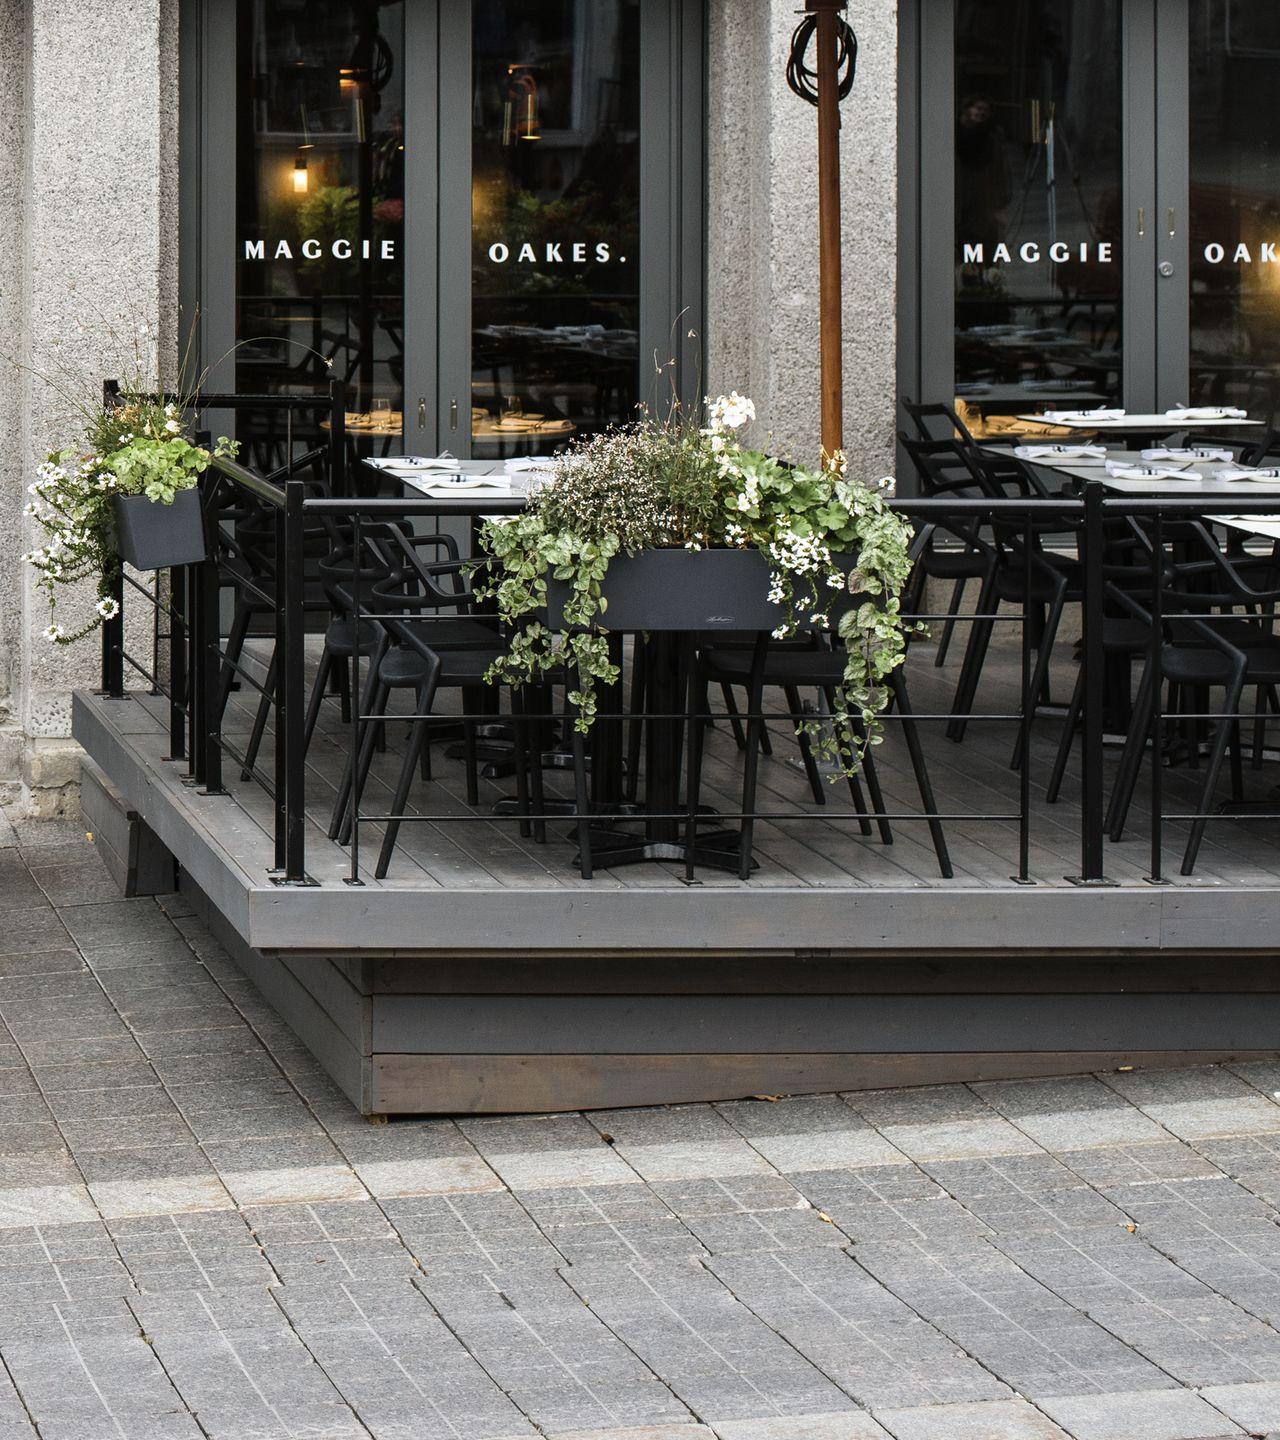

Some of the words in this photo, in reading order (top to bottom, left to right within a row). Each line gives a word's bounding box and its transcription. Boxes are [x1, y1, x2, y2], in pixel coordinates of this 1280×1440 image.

[245, 239, 395, 260] MAGGIE
[488, 242, 626, 263] OAKES.
[963, 242, 1112, 263] MAGGIE
[1204, 242, 1278, 264] OAK
